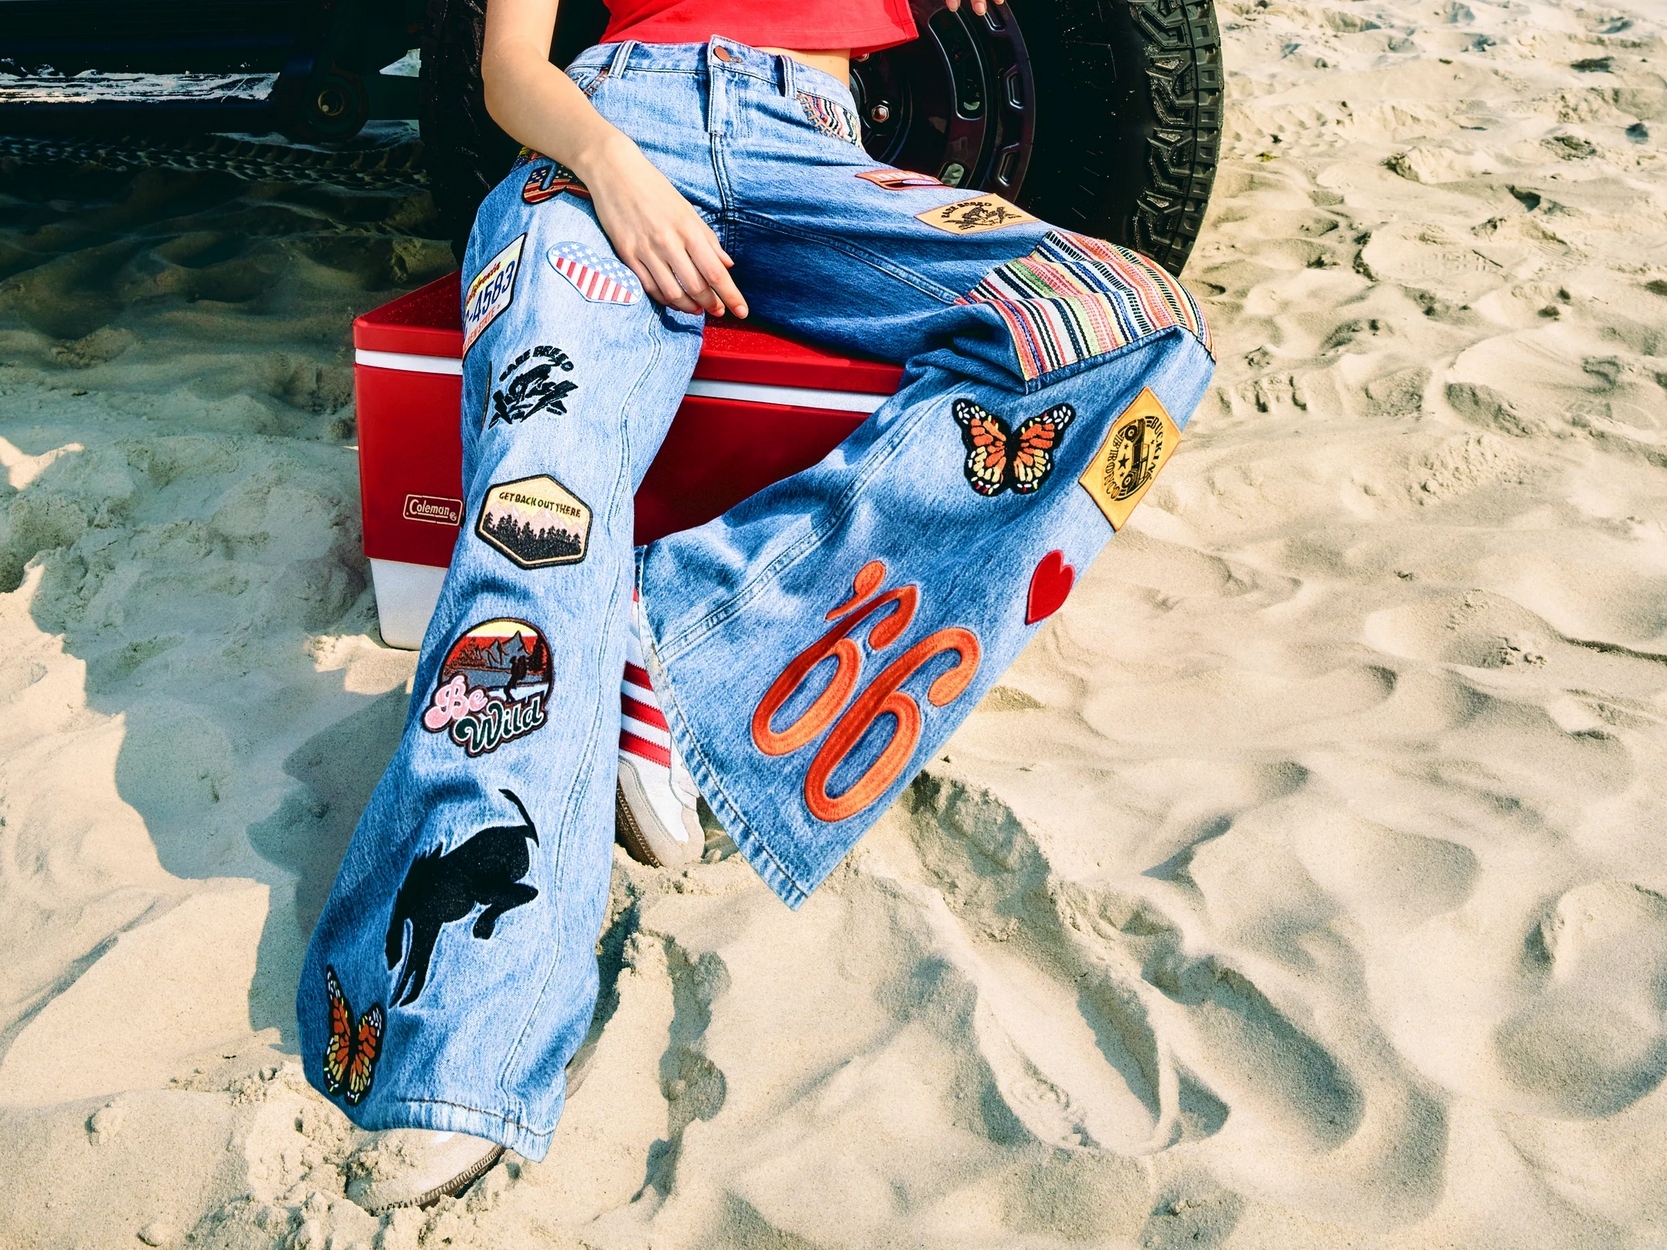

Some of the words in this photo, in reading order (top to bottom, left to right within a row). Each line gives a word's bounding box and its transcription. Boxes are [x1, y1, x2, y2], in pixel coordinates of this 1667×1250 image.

[409, 499, 450, 516] Coleman
[499, 492, 515, 502] GET
[514, 493, 537, 506] BACK
[537, 499, 555, 511] OUT
[555, 503, 582, 518] THERE
[424, 675, 488, 729] Be
[454, 695, 545, 753] Wild
